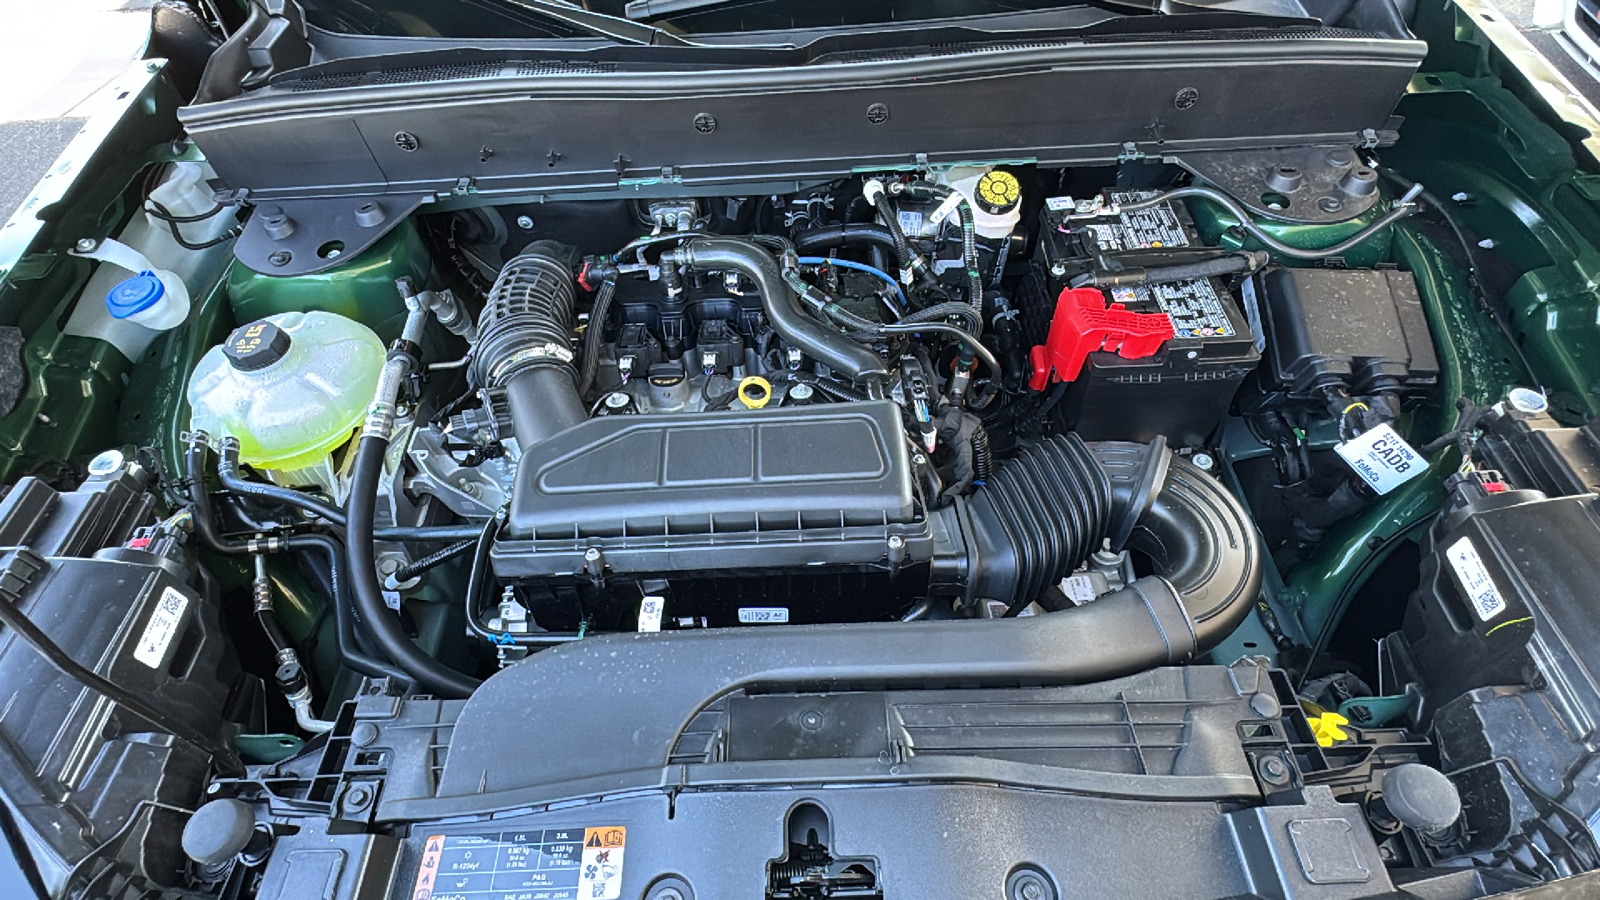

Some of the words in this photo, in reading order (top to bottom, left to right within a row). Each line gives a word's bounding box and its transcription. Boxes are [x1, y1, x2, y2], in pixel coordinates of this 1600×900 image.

[1372, 440, 1411, 473] CADB
[1355, 459, 1379, 482] FoMoCo
[452, 862, 480, 871] R-1234yf
